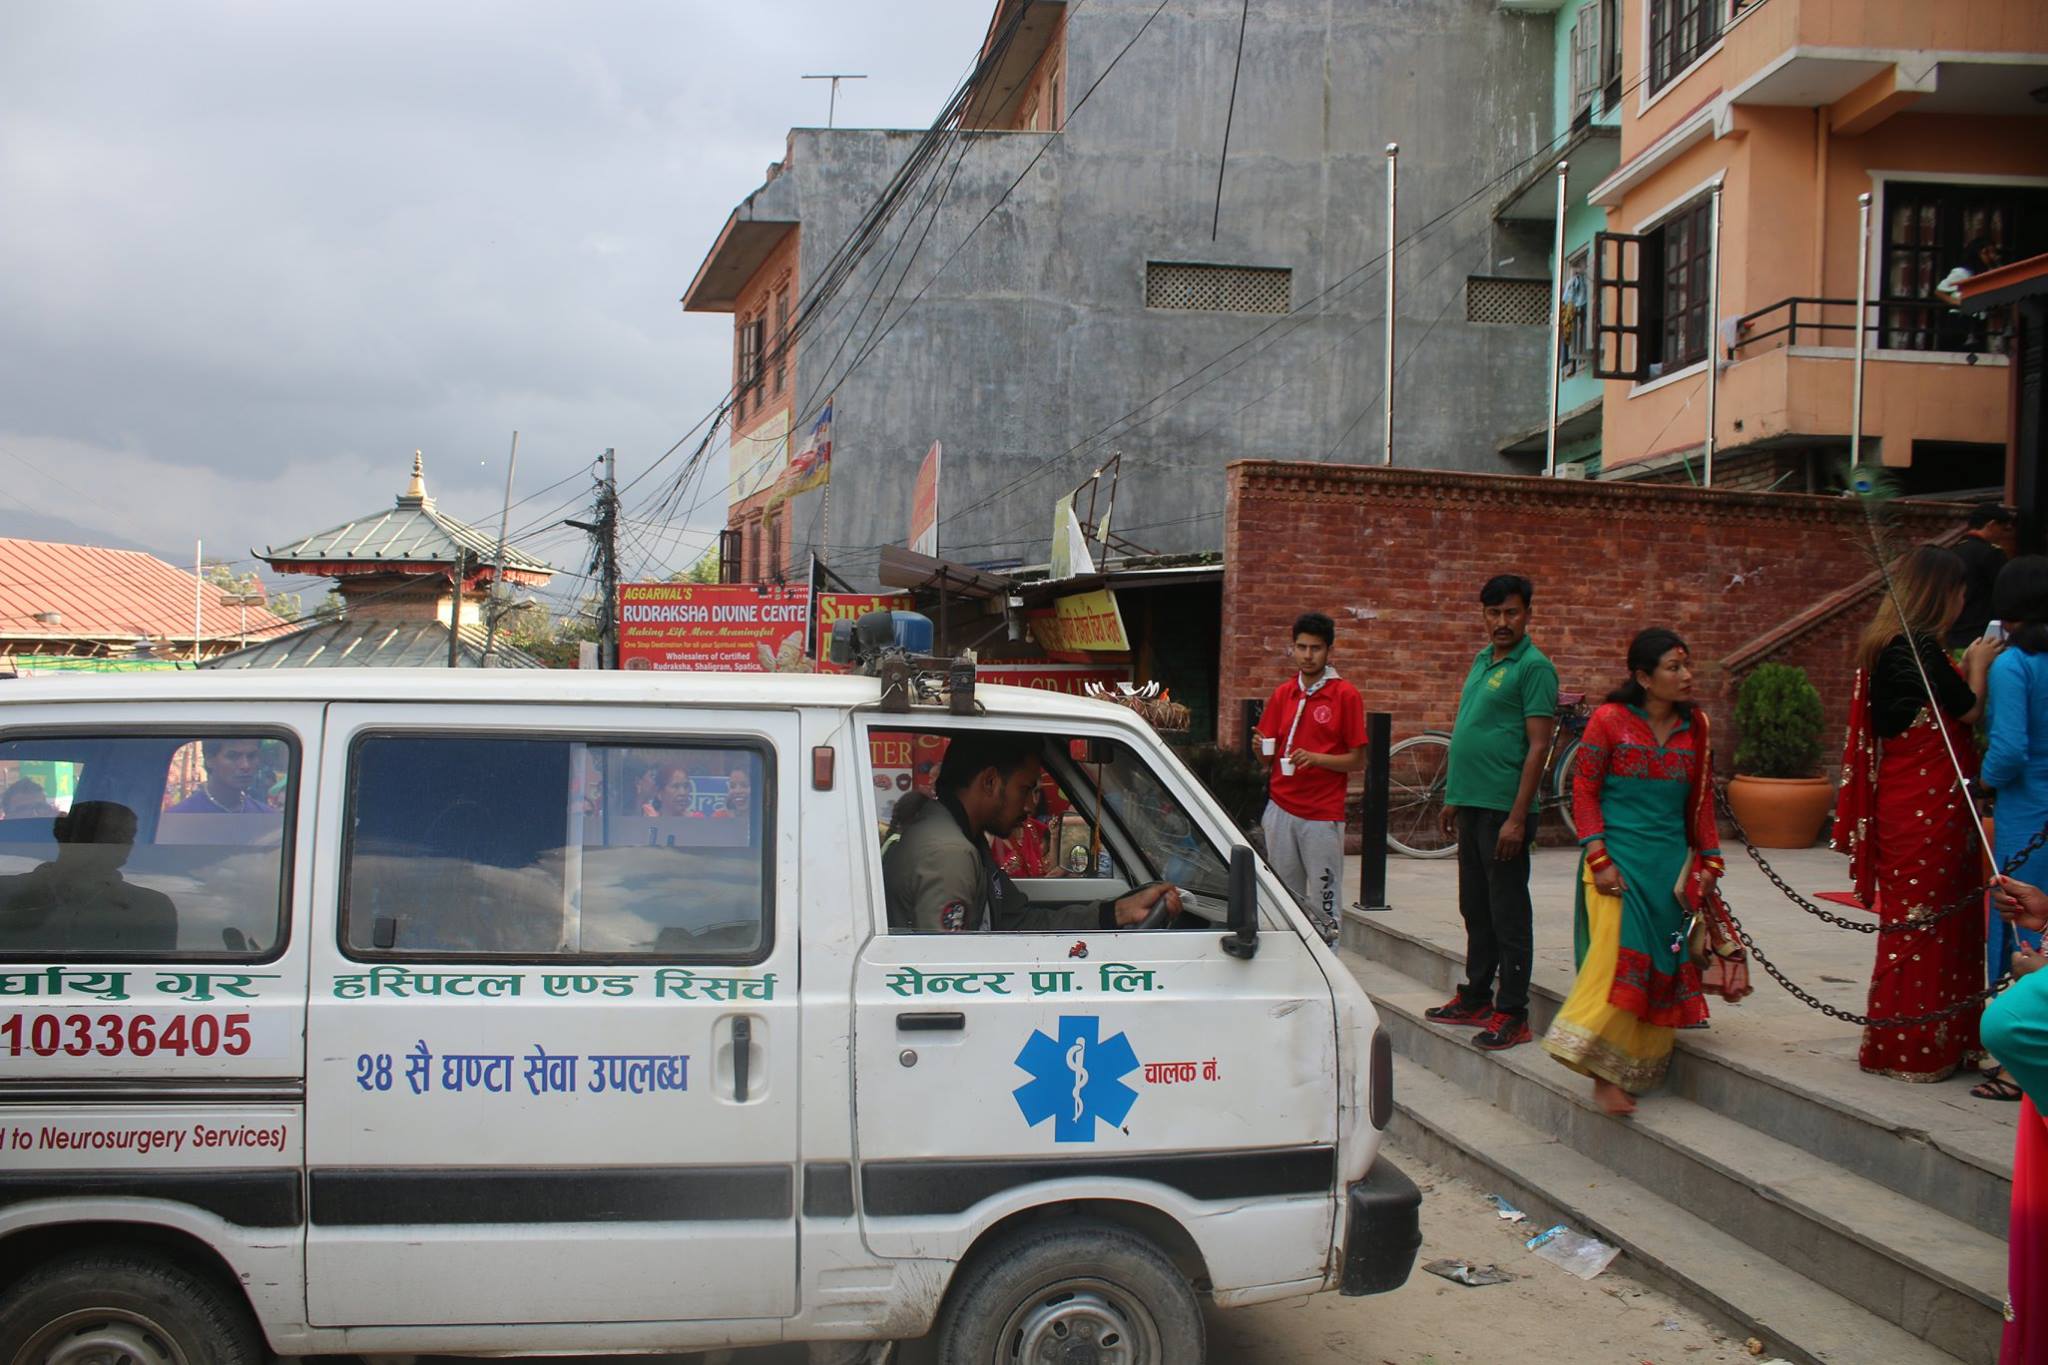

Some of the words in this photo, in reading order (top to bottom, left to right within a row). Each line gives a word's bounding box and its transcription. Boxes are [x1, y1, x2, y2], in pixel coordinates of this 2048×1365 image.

[624, 587, 693, 600] AGGARWAL'S
[623, 605, 708, 622] RUDRAKSHA
[712, 605, 758, 622] DIVINE
[761, 605, 808, 622] CENTE
[625, 627, 664, 638] Making
[666, 627, 687, 637] Life
[689, 627, 714, 637] More
[716, 627, 775, 638] Meaningful
[624, 641, 636, 649] One
[637, 641, 650, 650] Stop
[651, 641, 683, 649] Destination
[684, 641, 692, 649] for
[701, 642, 713, 650] your
[666, 652, 707, 661] Wholesalers
[708, 652, 717, 661] of
[719, 652, 750, 661] Certified
[653, 662, 693, 672] Rudraksha,
[695, 662, 732, 672] Shaligram,
[156, 972, 281, 1001] गुर
[332, 966, 525, 999] हस्पिटल
[541, 973, 639, 998] एण्ड
[654, 968, 779, 1001] रिसर्च
[885, 966, 1015, 996] सेन्टर
[1029, 971, 1083, 996] प्रा.
[1099, 963, 1164, 993] लि.
[1, 1013, 251, 1057] 10336405
[356, 1053, 393, 1092] २४
[442, 1055, 514, 1092] घण्टा
[524, 1044, 578, 1095] सेवा
[588, 1054, 690, 1094] उपलब्ध
[1144, 1062, 1197, 1084] चालक
[1202, 1057, 1221, 1082] नं.
[12, 1127, 33, 1150] to
[39, 1127, 187, 1153] Neurosurgery
[192, 1125, 287, 1152] Services)
